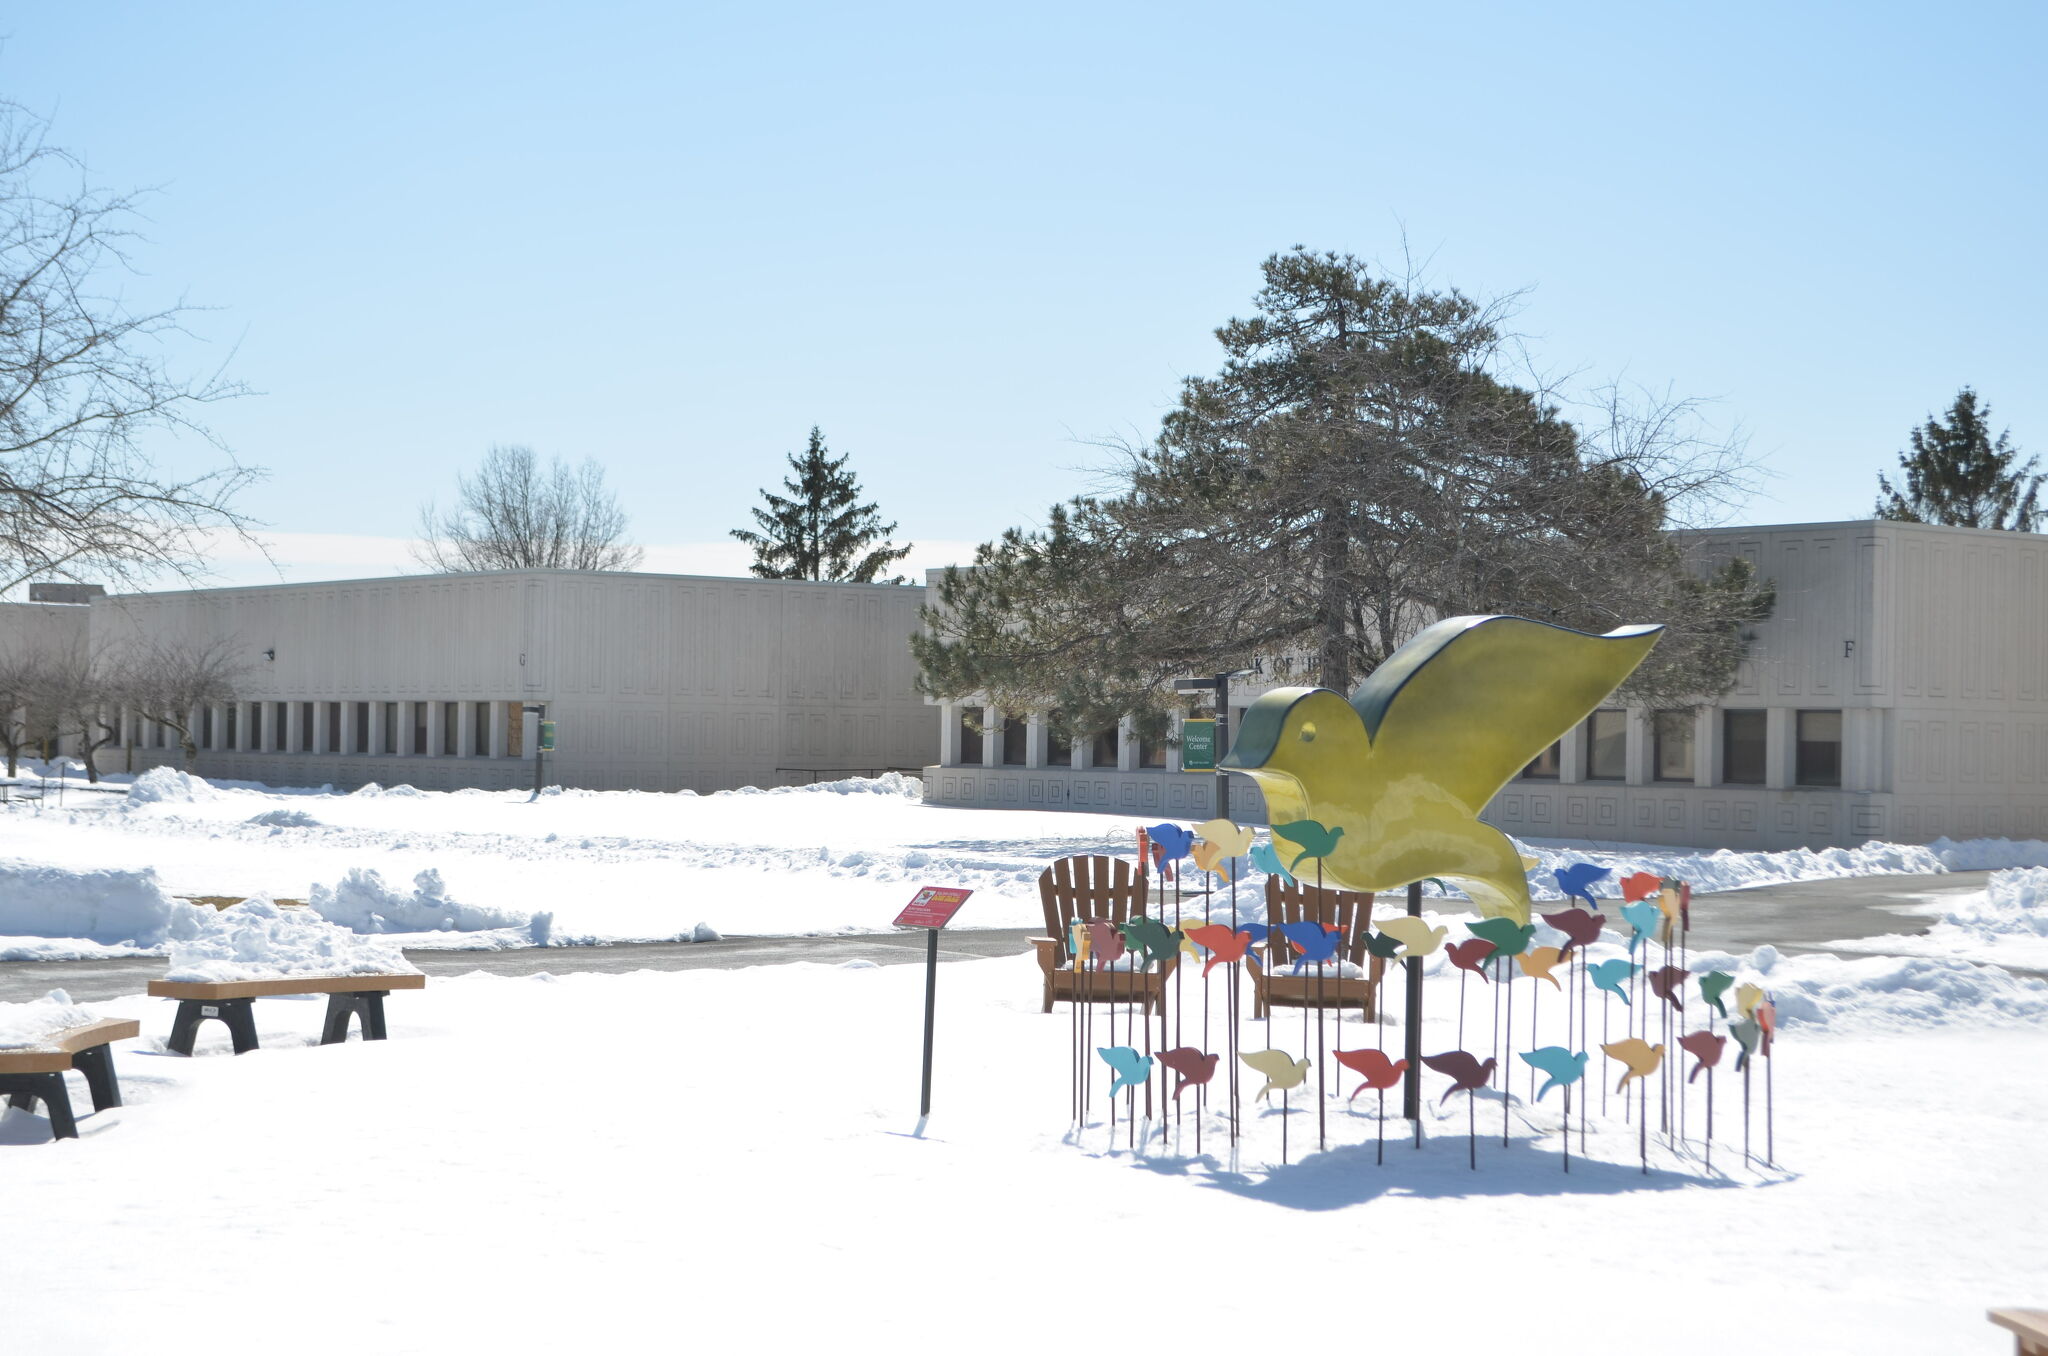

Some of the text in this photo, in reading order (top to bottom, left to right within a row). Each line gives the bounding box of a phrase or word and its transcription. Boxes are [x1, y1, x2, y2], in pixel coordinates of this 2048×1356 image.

[1843, 640, 1855, 658] F
[1186, 735, 1211, 743] Welcome
[1188, 742, 1208, 750] Center
